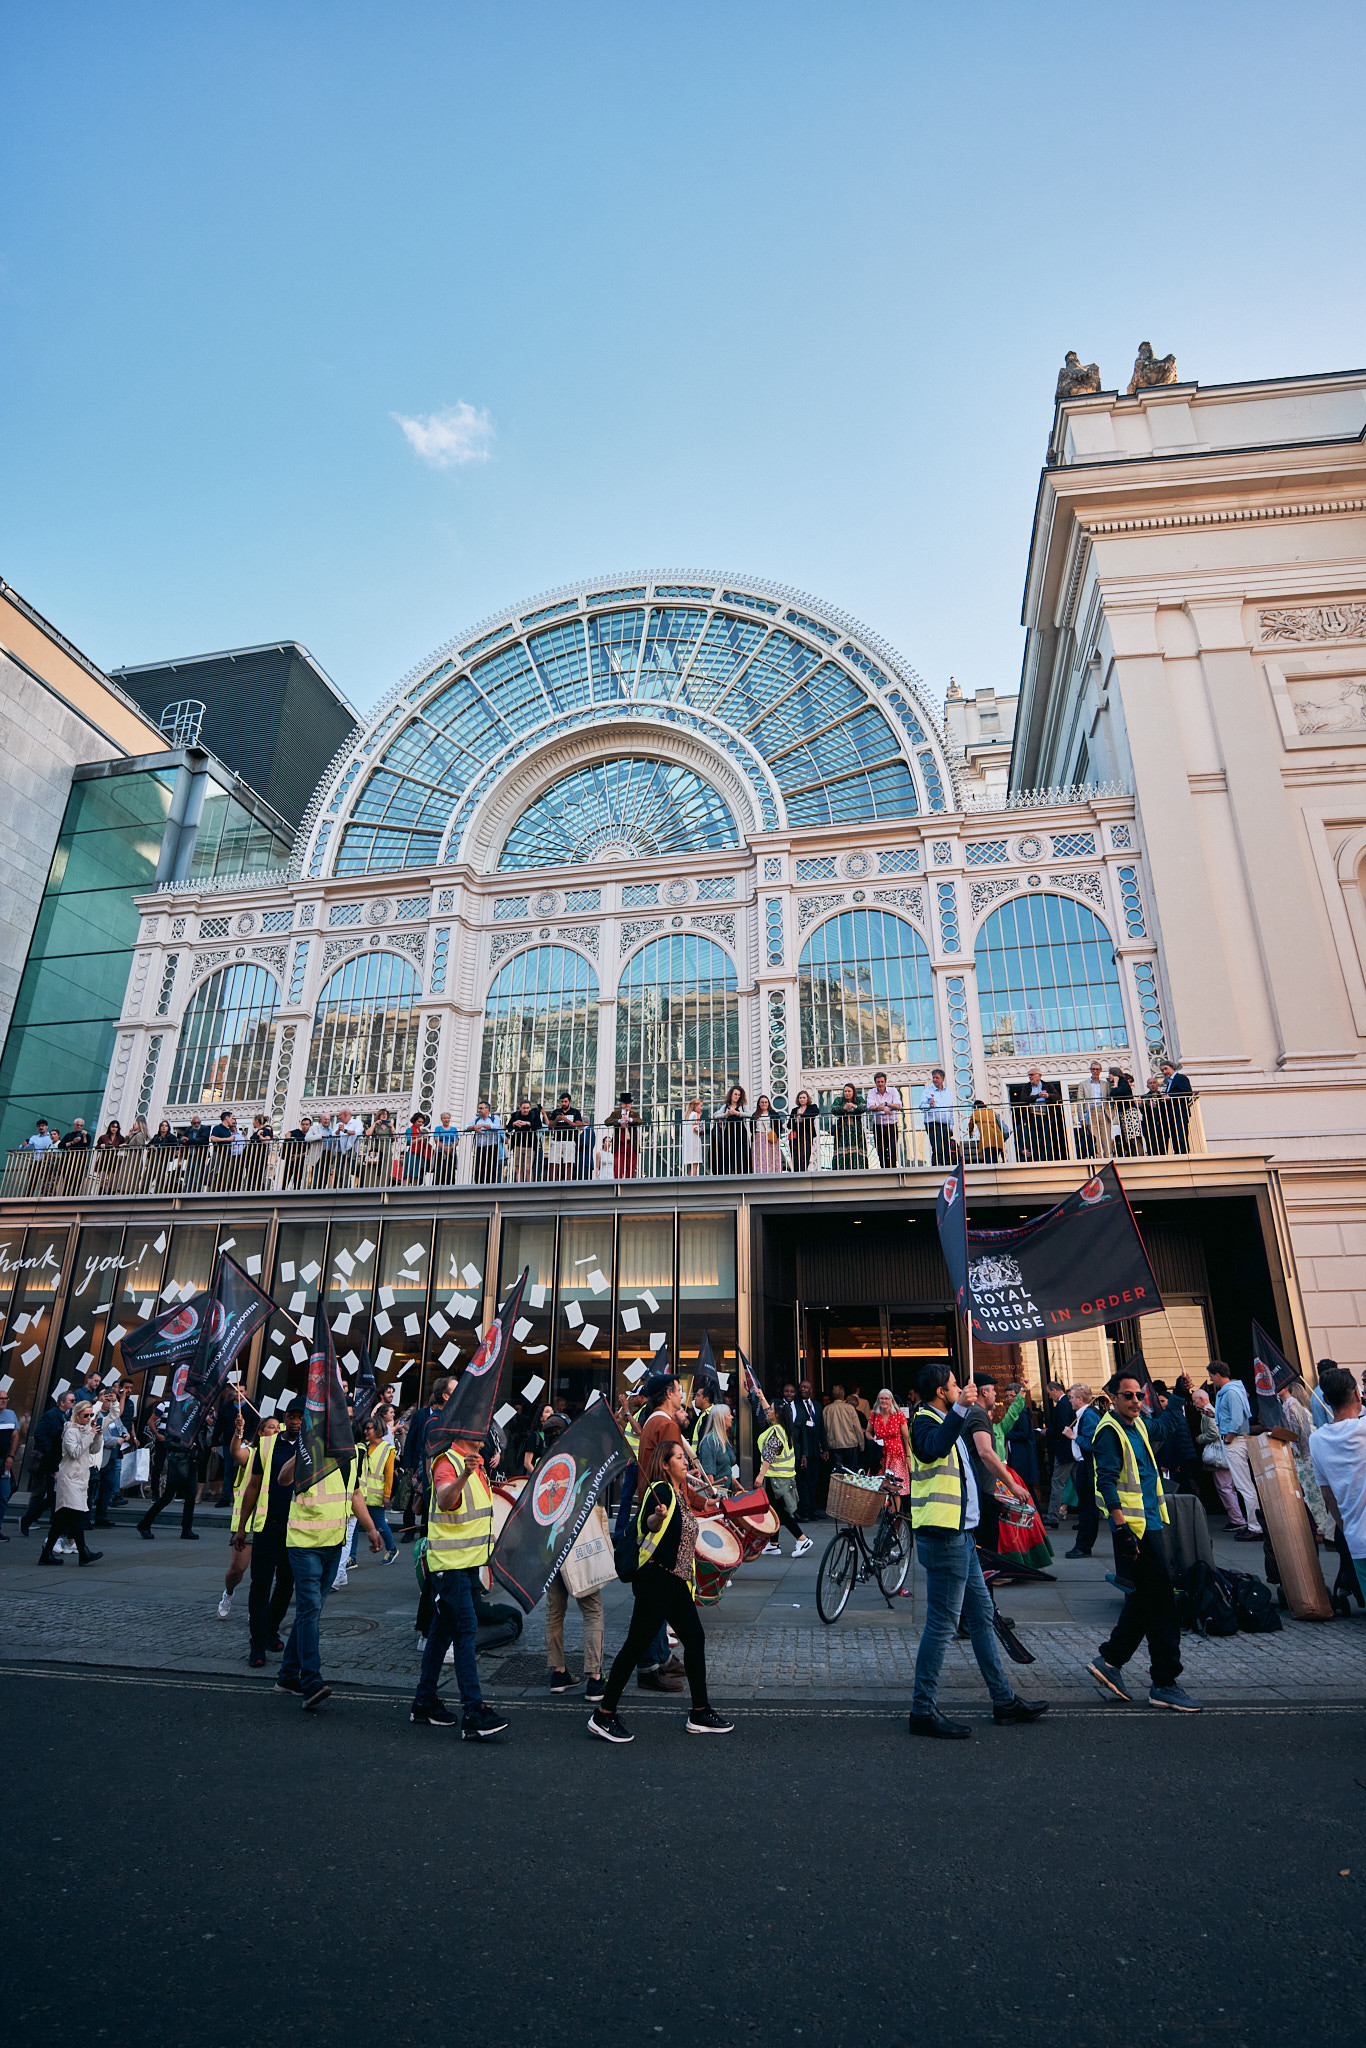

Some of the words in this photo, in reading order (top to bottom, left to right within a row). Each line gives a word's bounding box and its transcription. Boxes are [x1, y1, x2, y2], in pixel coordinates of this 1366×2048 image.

[74, 1243, 149, 1297] you!
[972, 1286, 1032, 1305] ROYAL
[1050, 1308, 1071, 1324] IN
[1080, 1286, 1146, 1315] ORDER
[979, 1301, 1039, 1318] OPERA
[986, 1315, 1045, 1332] HOUSE
